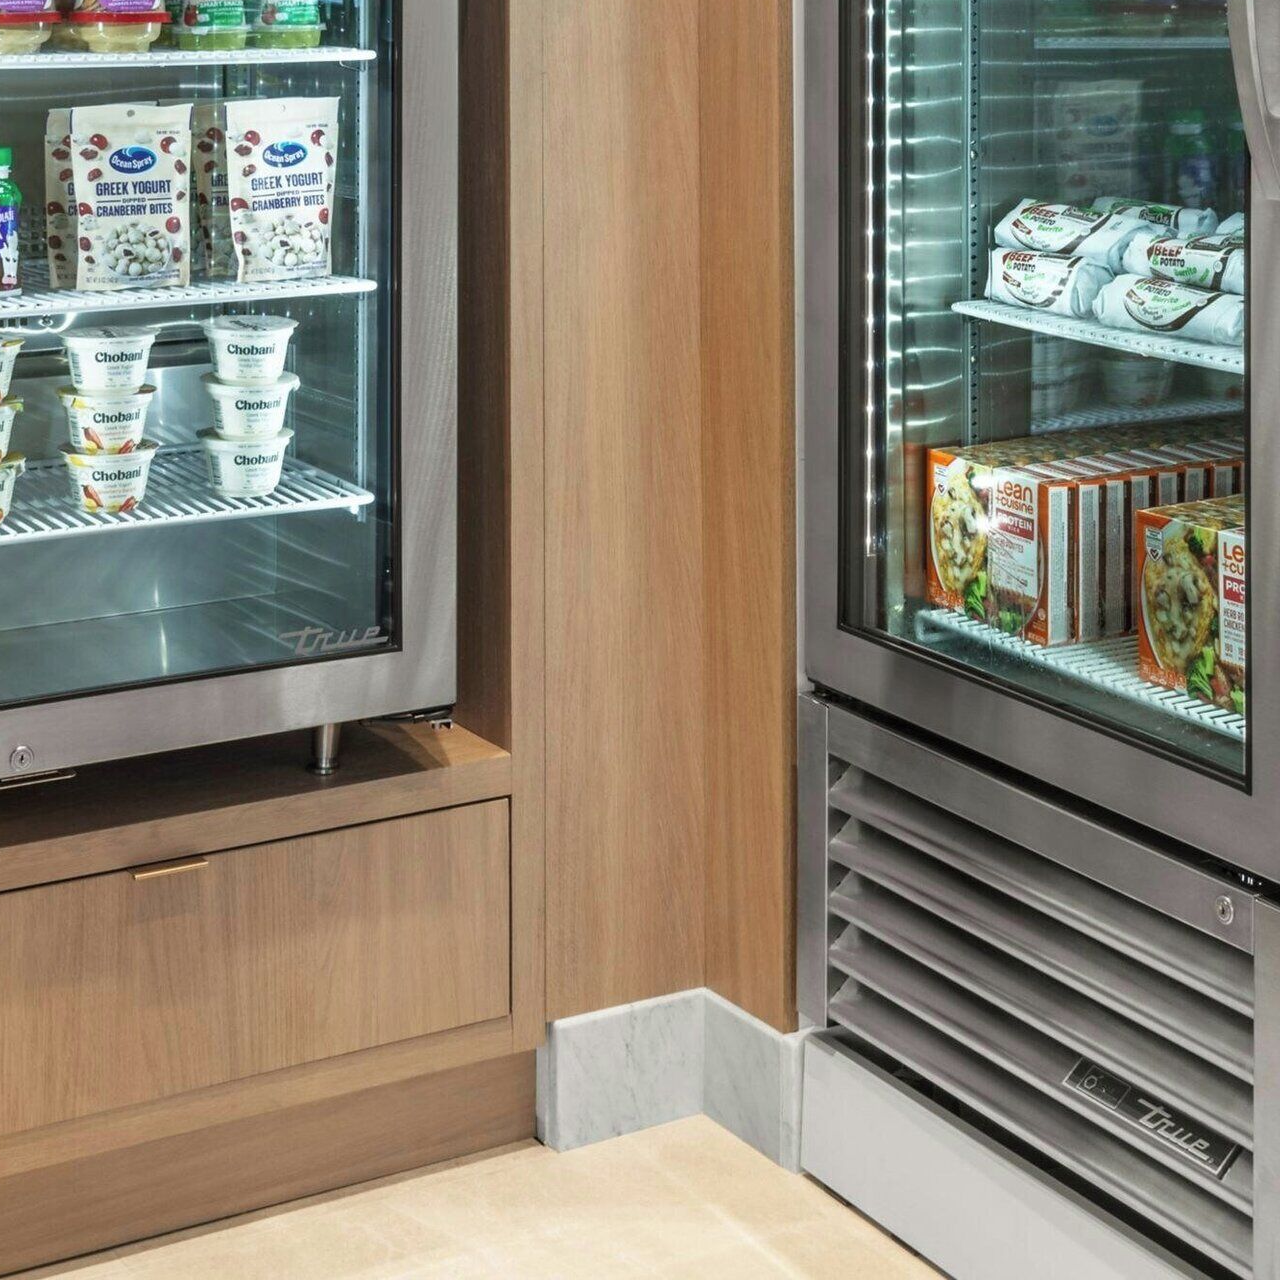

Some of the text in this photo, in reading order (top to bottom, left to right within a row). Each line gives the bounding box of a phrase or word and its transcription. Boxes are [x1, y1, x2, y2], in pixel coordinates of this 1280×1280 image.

[96, 180, 171, 195] GREEK YOGURT
[251, 172, 324, 191] GREEK YOGURT
[252, 194, 325, 211] CRANBERRY BITES
[97, 203, 173, 217] CRANBERRY BITES
[1154, 245, 1182, 257] BEEF
[1160, 257, 1185, 267] POTATO
[95, 349, 143, 363] Chobani
[227, 344, 276, 355] Chobani
[235, 399, 282, 411] Chobani
[93, 410, 140, 423] Chobani
[92, 469, 141, 482] Chobani
